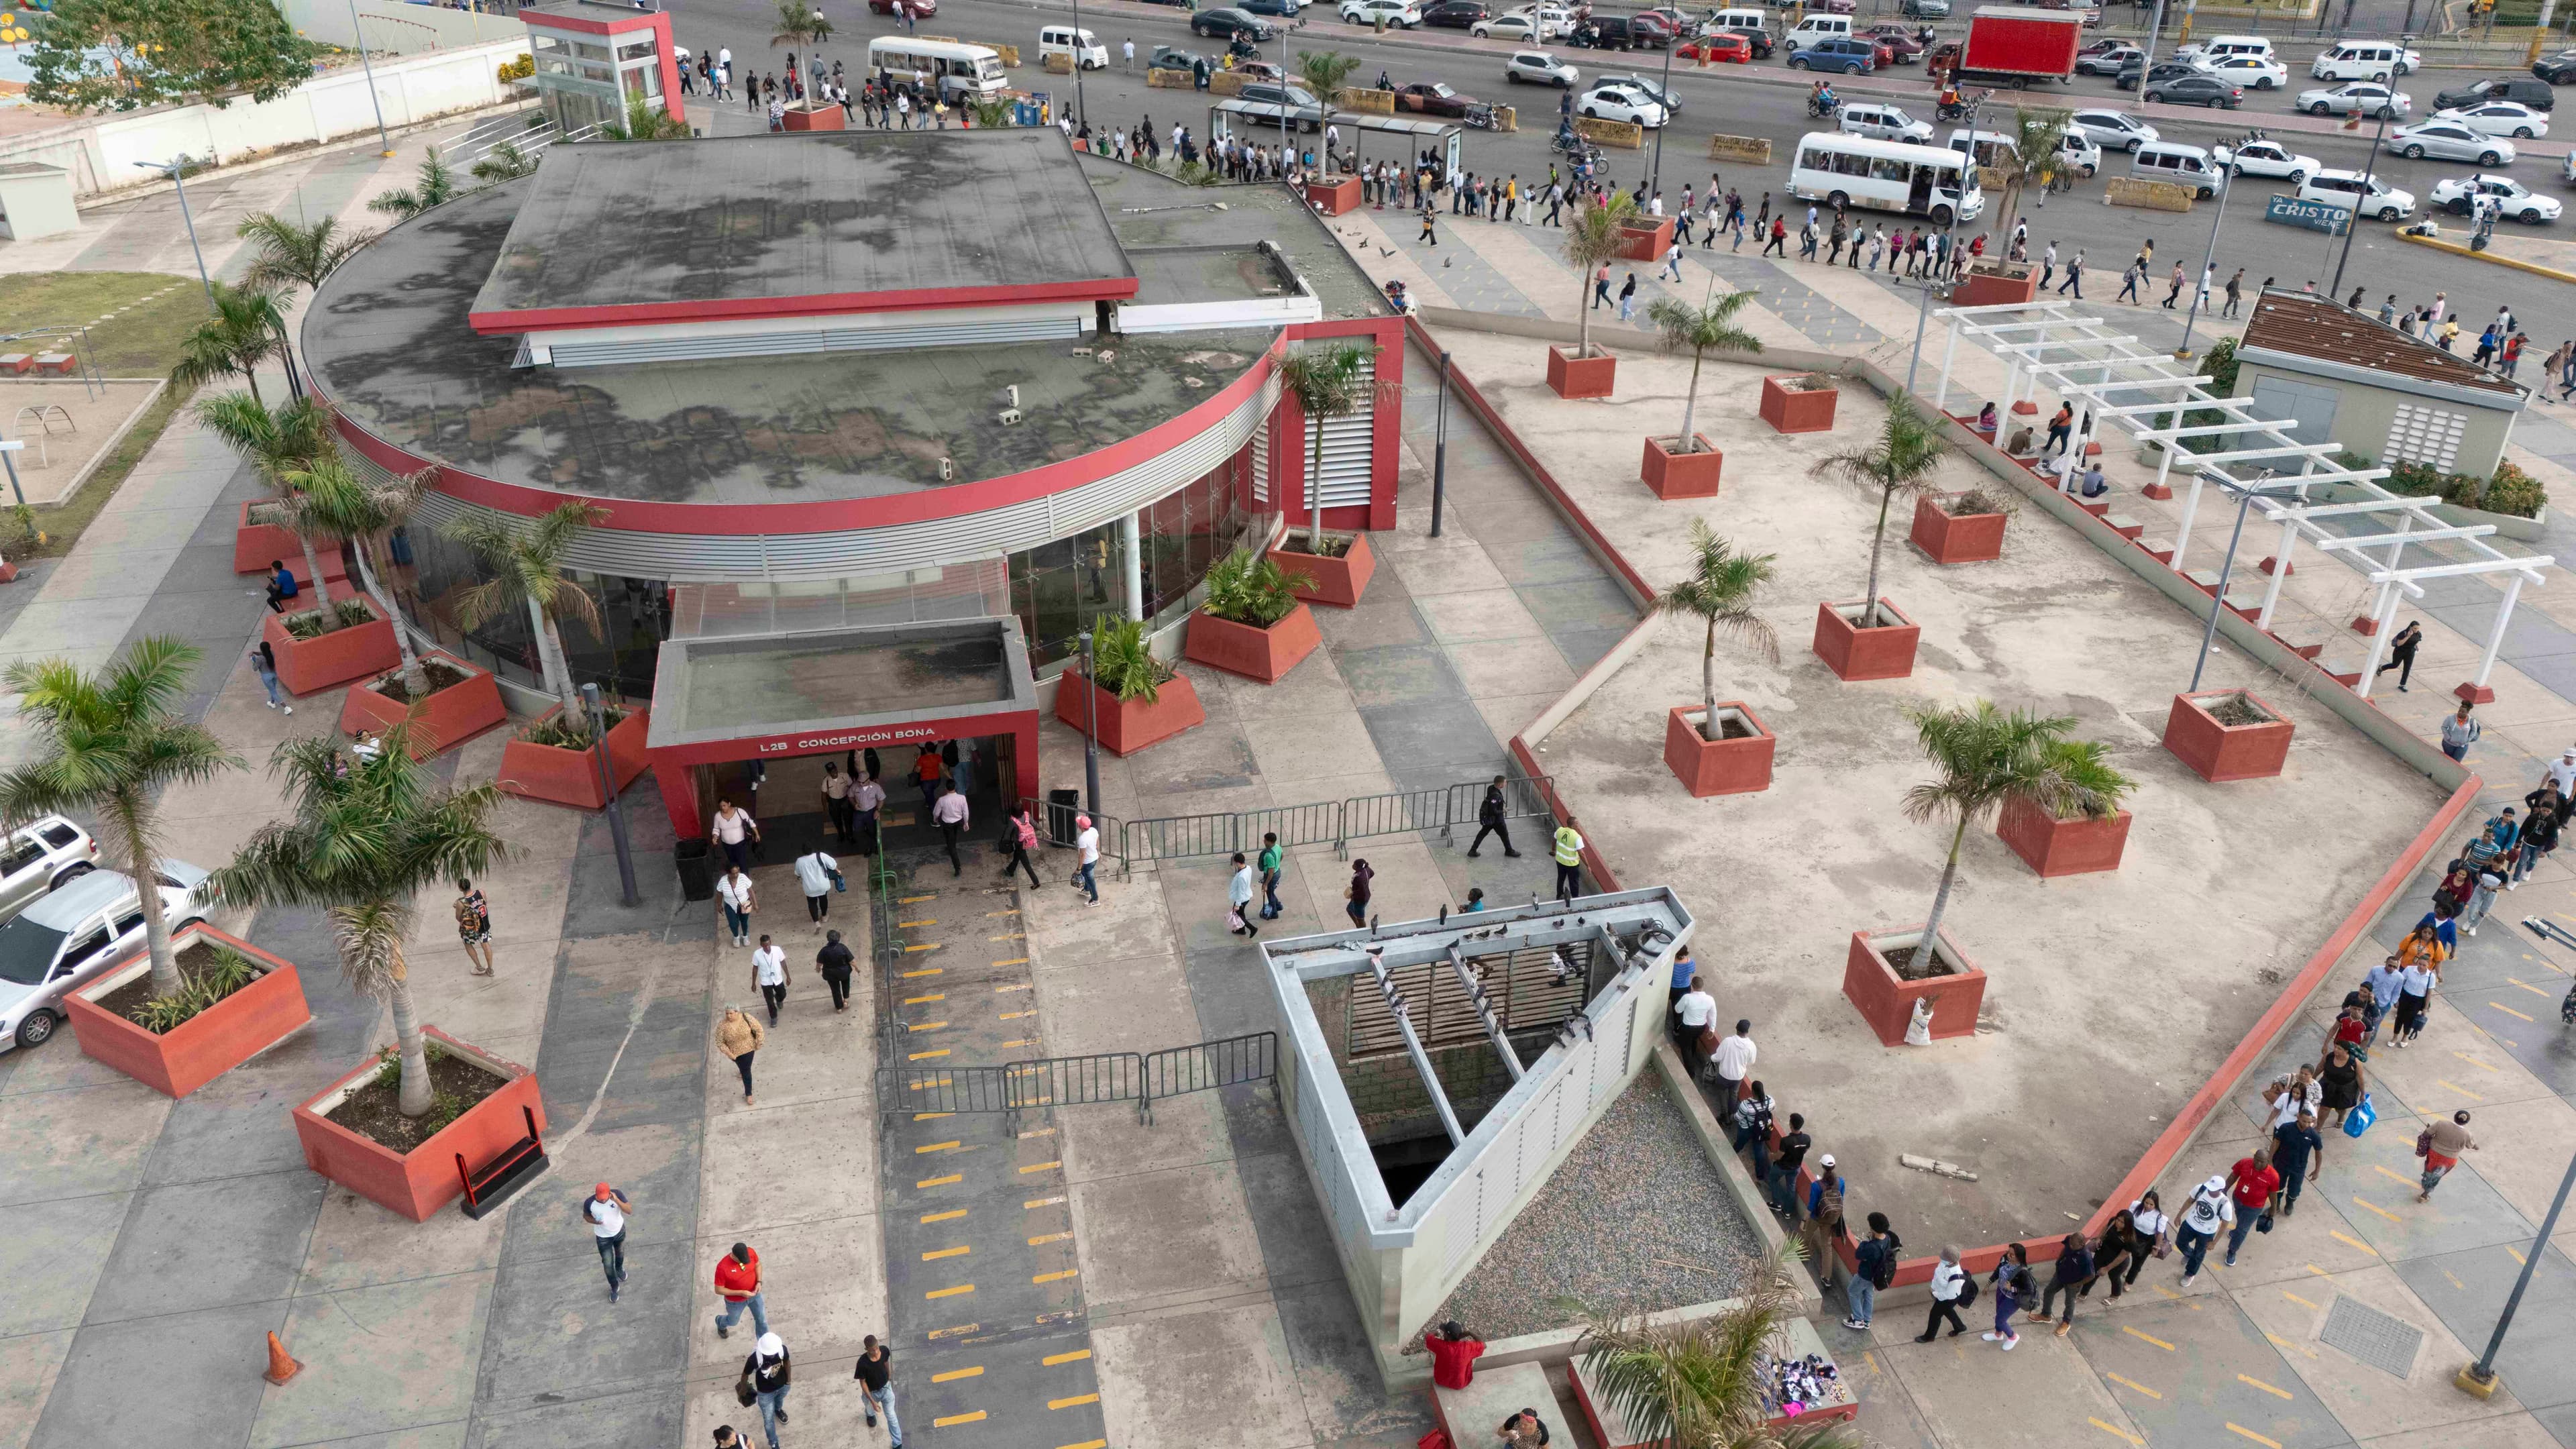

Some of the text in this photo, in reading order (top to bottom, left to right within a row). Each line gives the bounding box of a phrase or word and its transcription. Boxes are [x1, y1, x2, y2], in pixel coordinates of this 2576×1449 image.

[2273, 204, 2347, 221] CRISTO
[2314, 219, 2343, 229] VIENE
[798, 732, 891, 748] CONCEPCIÓN
[896, 728, 934, 739] BONA
